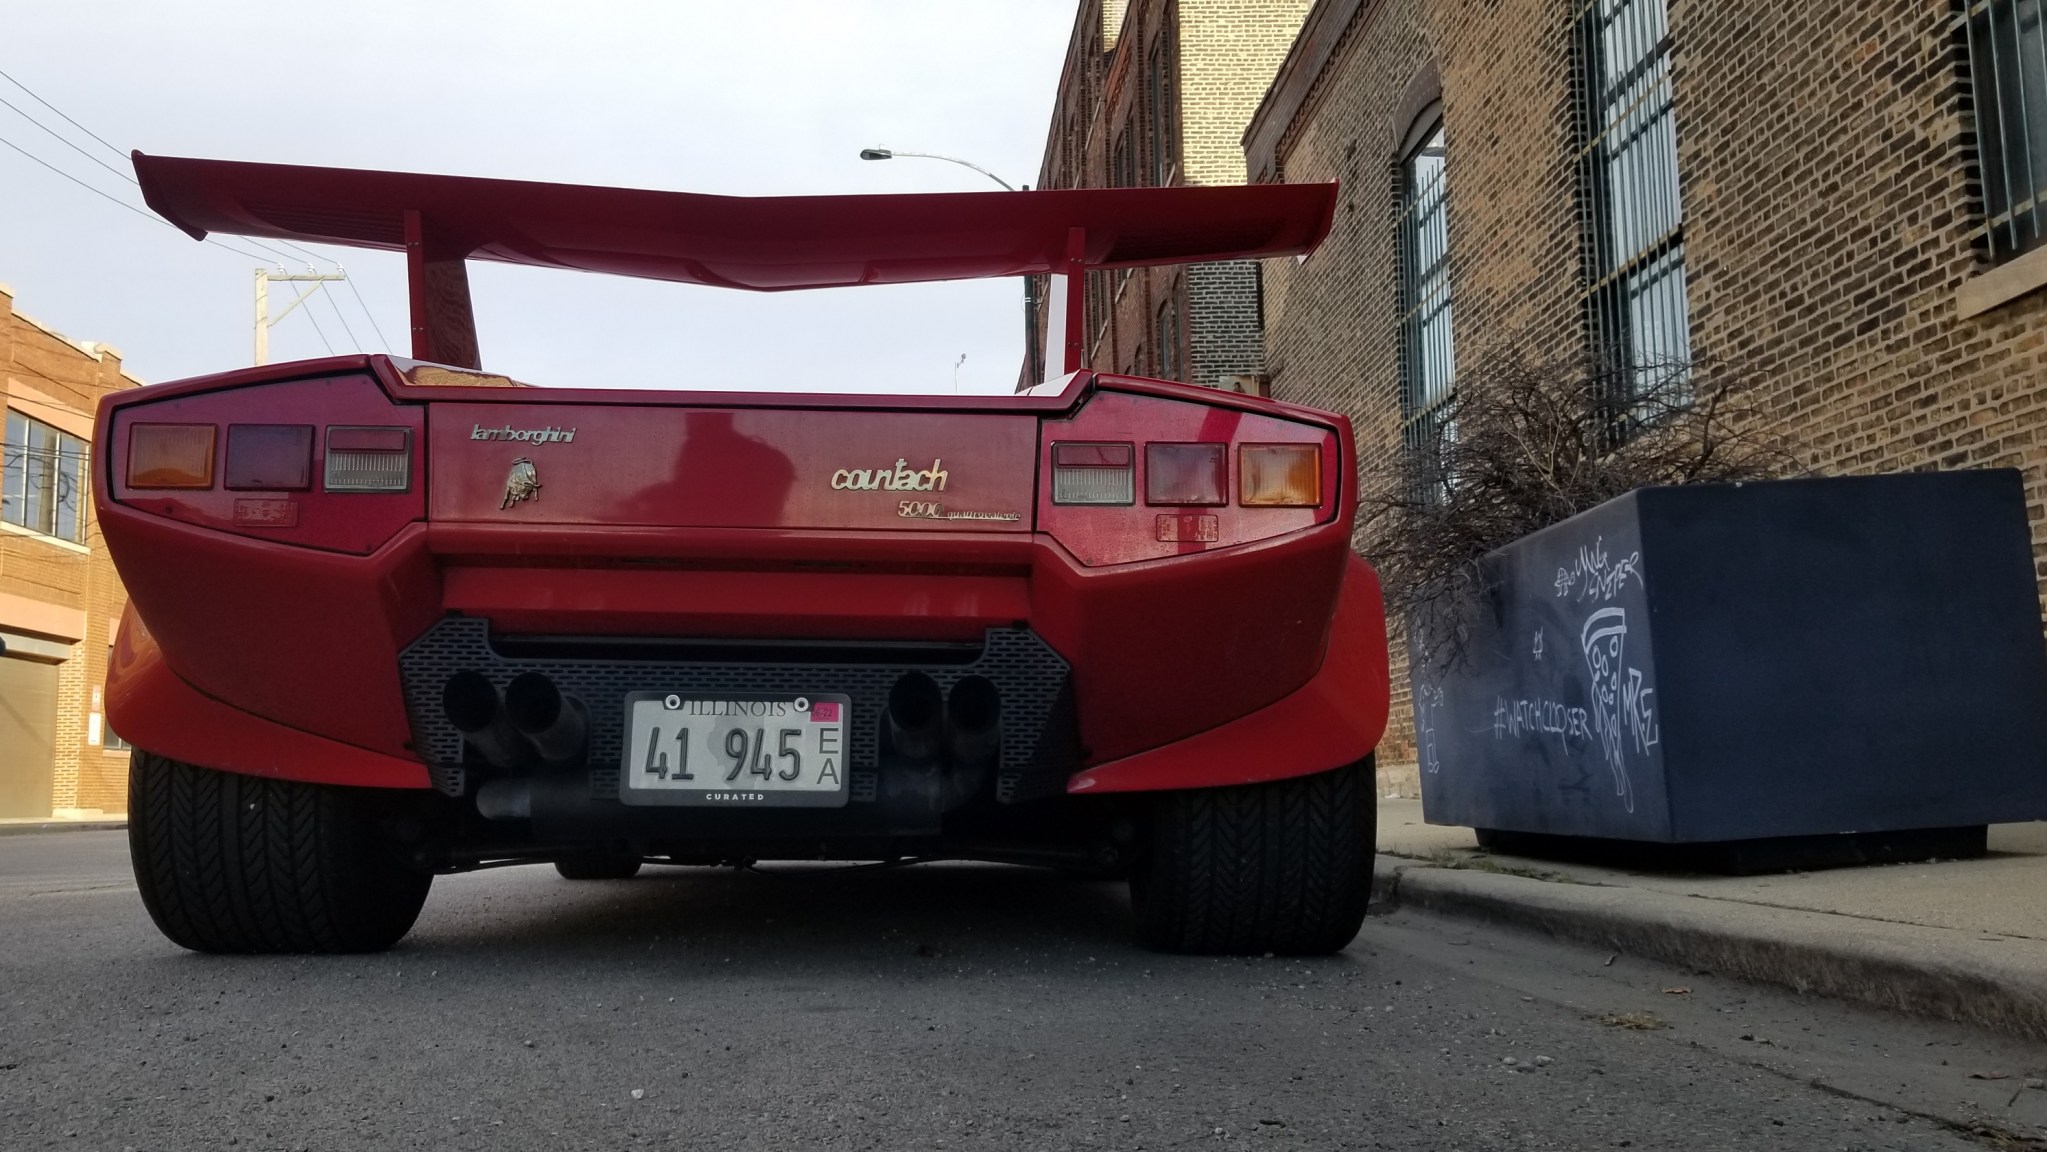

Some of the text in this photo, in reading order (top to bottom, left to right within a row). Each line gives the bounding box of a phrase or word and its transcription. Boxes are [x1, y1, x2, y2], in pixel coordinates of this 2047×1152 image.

[470, 424, 577, 446] lamborghini
[831, 458, 949, 491] countach
[897, 500, 945, 518] 5000
[689, 700, 787, 717] ILLINOIS
[645, 726, 802, 781] 41 945
[706, 793, 764, 801] CURATED
